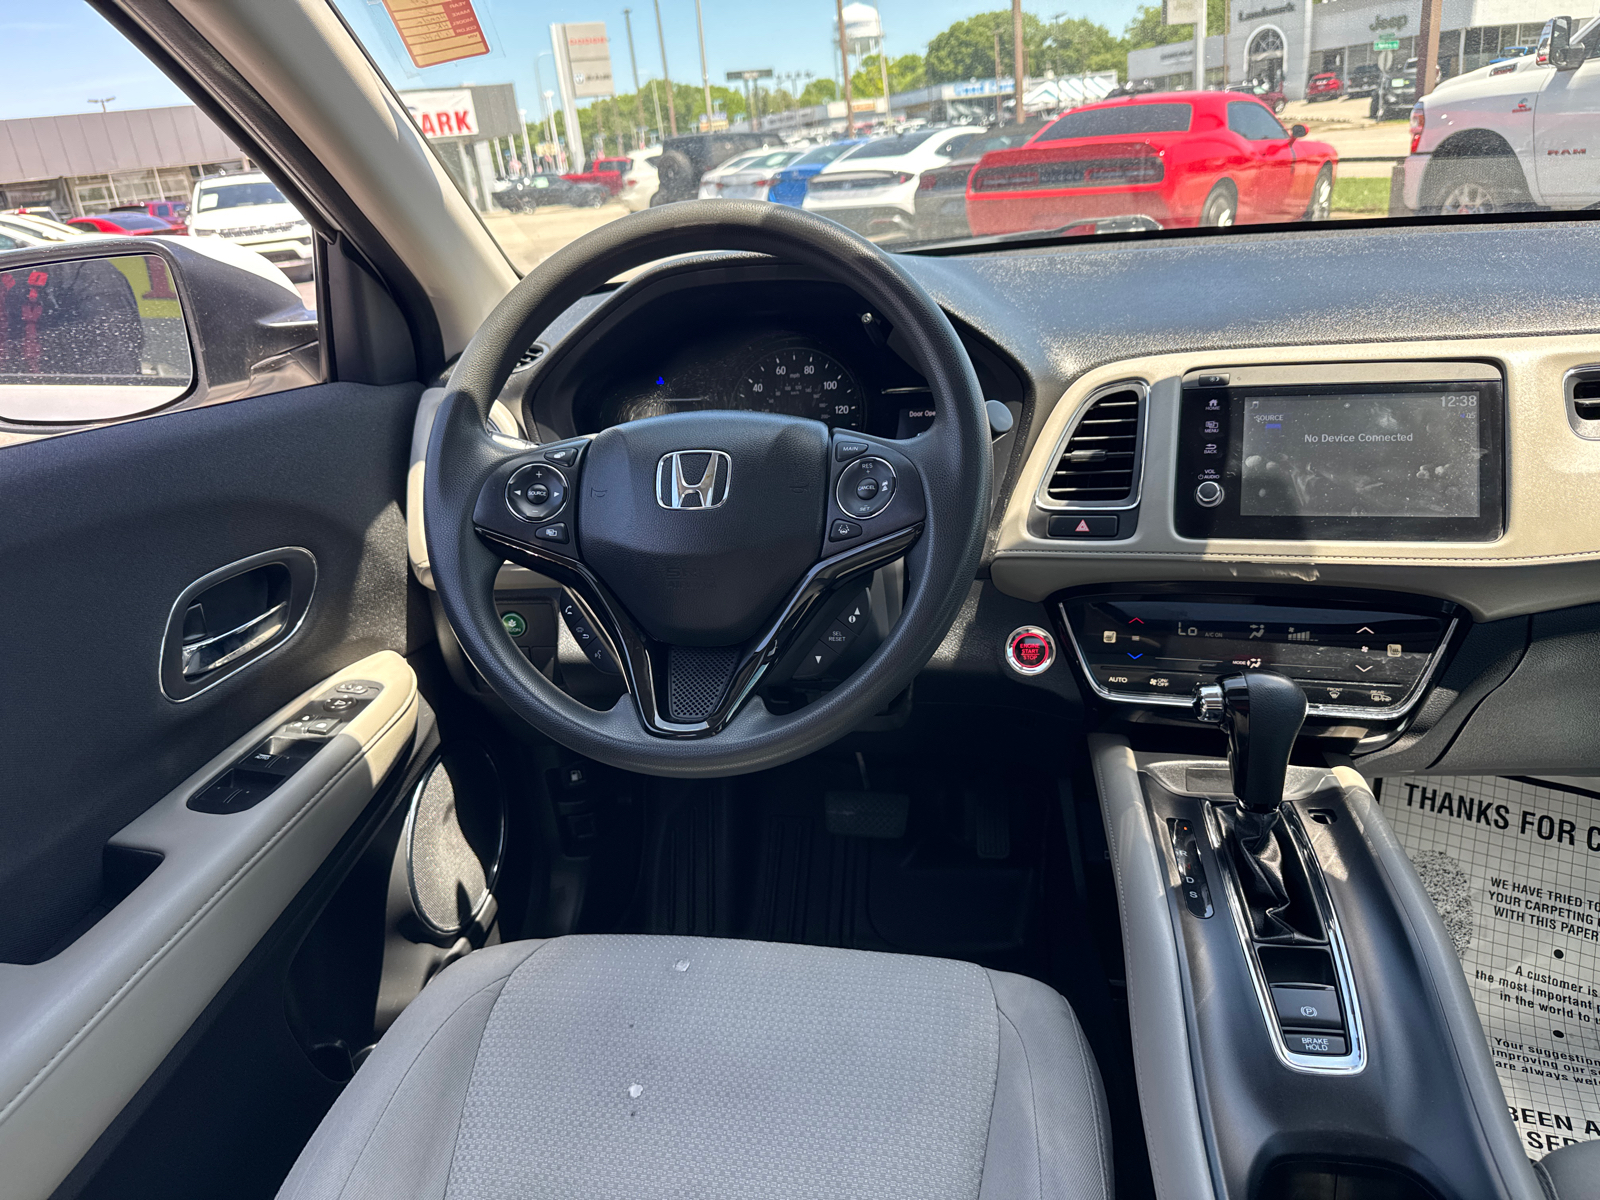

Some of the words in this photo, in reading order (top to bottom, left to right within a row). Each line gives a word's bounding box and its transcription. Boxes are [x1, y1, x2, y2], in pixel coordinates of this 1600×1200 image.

[1369, 14, 1408, 31] Jeep
[412, 110, 474, 137] ARK
[776, 366, 787, 375] 60
[804, 365, 815, 375] 80
[752, 383, 763, 392] 40
[823, 381, 838, 390] 100
[835, 405, 849, 414] 120
[1440, 395, 1478, 407] 12:38
[1304, 434, 1319, 443] No
[1321, 433, 1355, 443] Device
[1358, 433, 1413, 443] Connected
[1108, 676, 1128, 684] AUTO
[1404, 782, 1510, 830] THANKS
[1520, 810, 1576, 846] FOR
[1185, 876, 1195, 884] D
[1189, 891, 1198, 899] S
[1490, 876, 1509, 890] WE
[1512, 882, 1543, 899] HAVE
[1547, 890, 1583, 908] TRIED
[1586, 899, 1600, 913] TO
[1488, 890, 1521, 907] YOUR
[1524, 899, 1594, 926] CARPETING
[1493, 905, 1525, 923] WITH
[1528, 912, 1556, 930] THIS
[1560, 921, 1599, 942] PAPER
[1475, 969, 1494, 983] the
[1498, 978, 1528, 994] most
[1532, 985, 1593, 1010] important
[1515, 965, 1523, 977] A
[1527, 970, 1583, 994] customer
[1587, 985, 1598, 998] is
[1499, 991, 1511, 1003] in
[1515, 993, 1535, 1009] the
[1538, 1002, 1574, 1019] world
[1578, 1011, 1591, 1023] to
[1301, 1037, 1329, 1045] BRAKE
[1494, 1037, 1524, 1051] Your
[1491, 1047, 1559, 1071] improving
[1563, 1063, 1585, 1074] our
[1495, 1060, 1516, 1071] are
[1521, 1065, 1569, 1081] always
[1573, 1075, 1600, 1086] wel
[1507, 1106, 1574, 1132] BEEN
